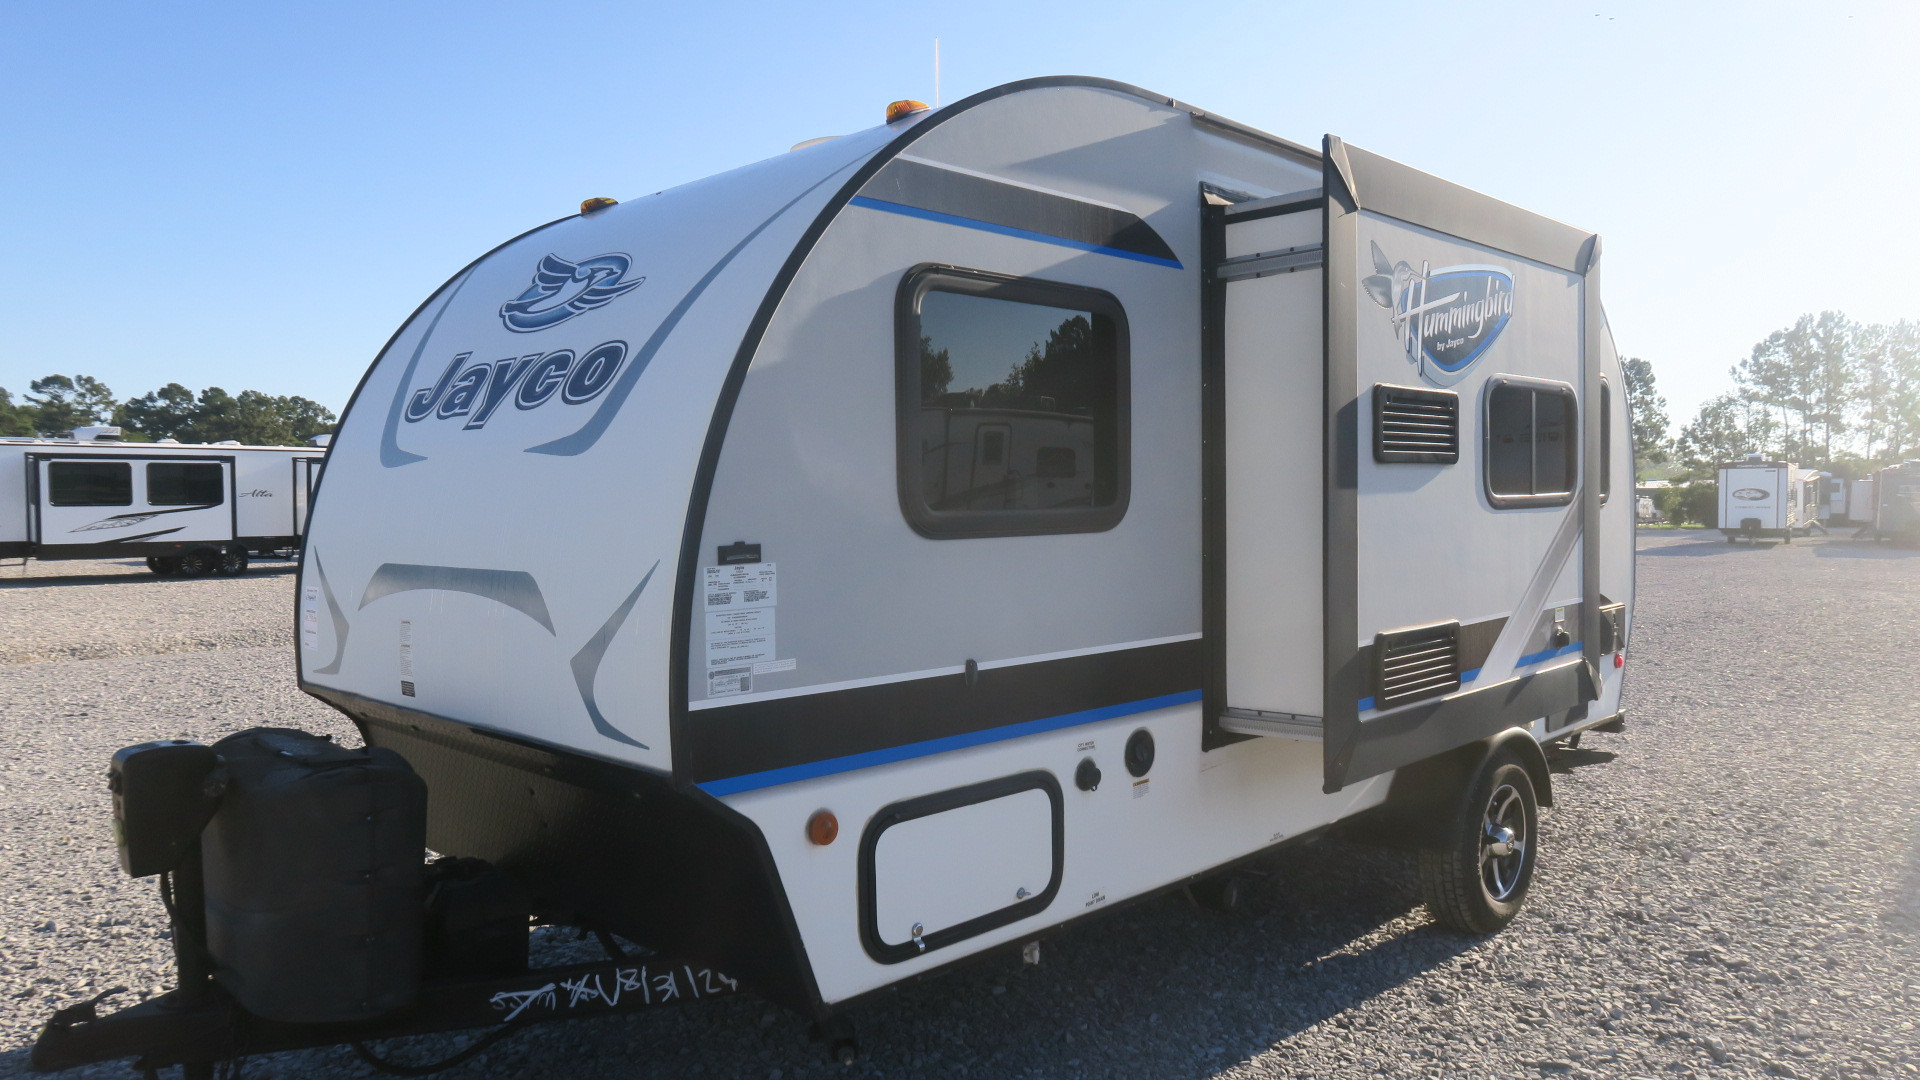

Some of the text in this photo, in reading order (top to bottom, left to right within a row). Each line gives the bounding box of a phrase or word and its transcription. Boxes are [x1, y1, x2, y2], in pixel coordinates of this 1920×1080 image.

[1392, 260, 1515, 376] Hummingbird
[1436, 337, 1465, 352] by Jayco
[404, 340, 629, 431] Jayco
